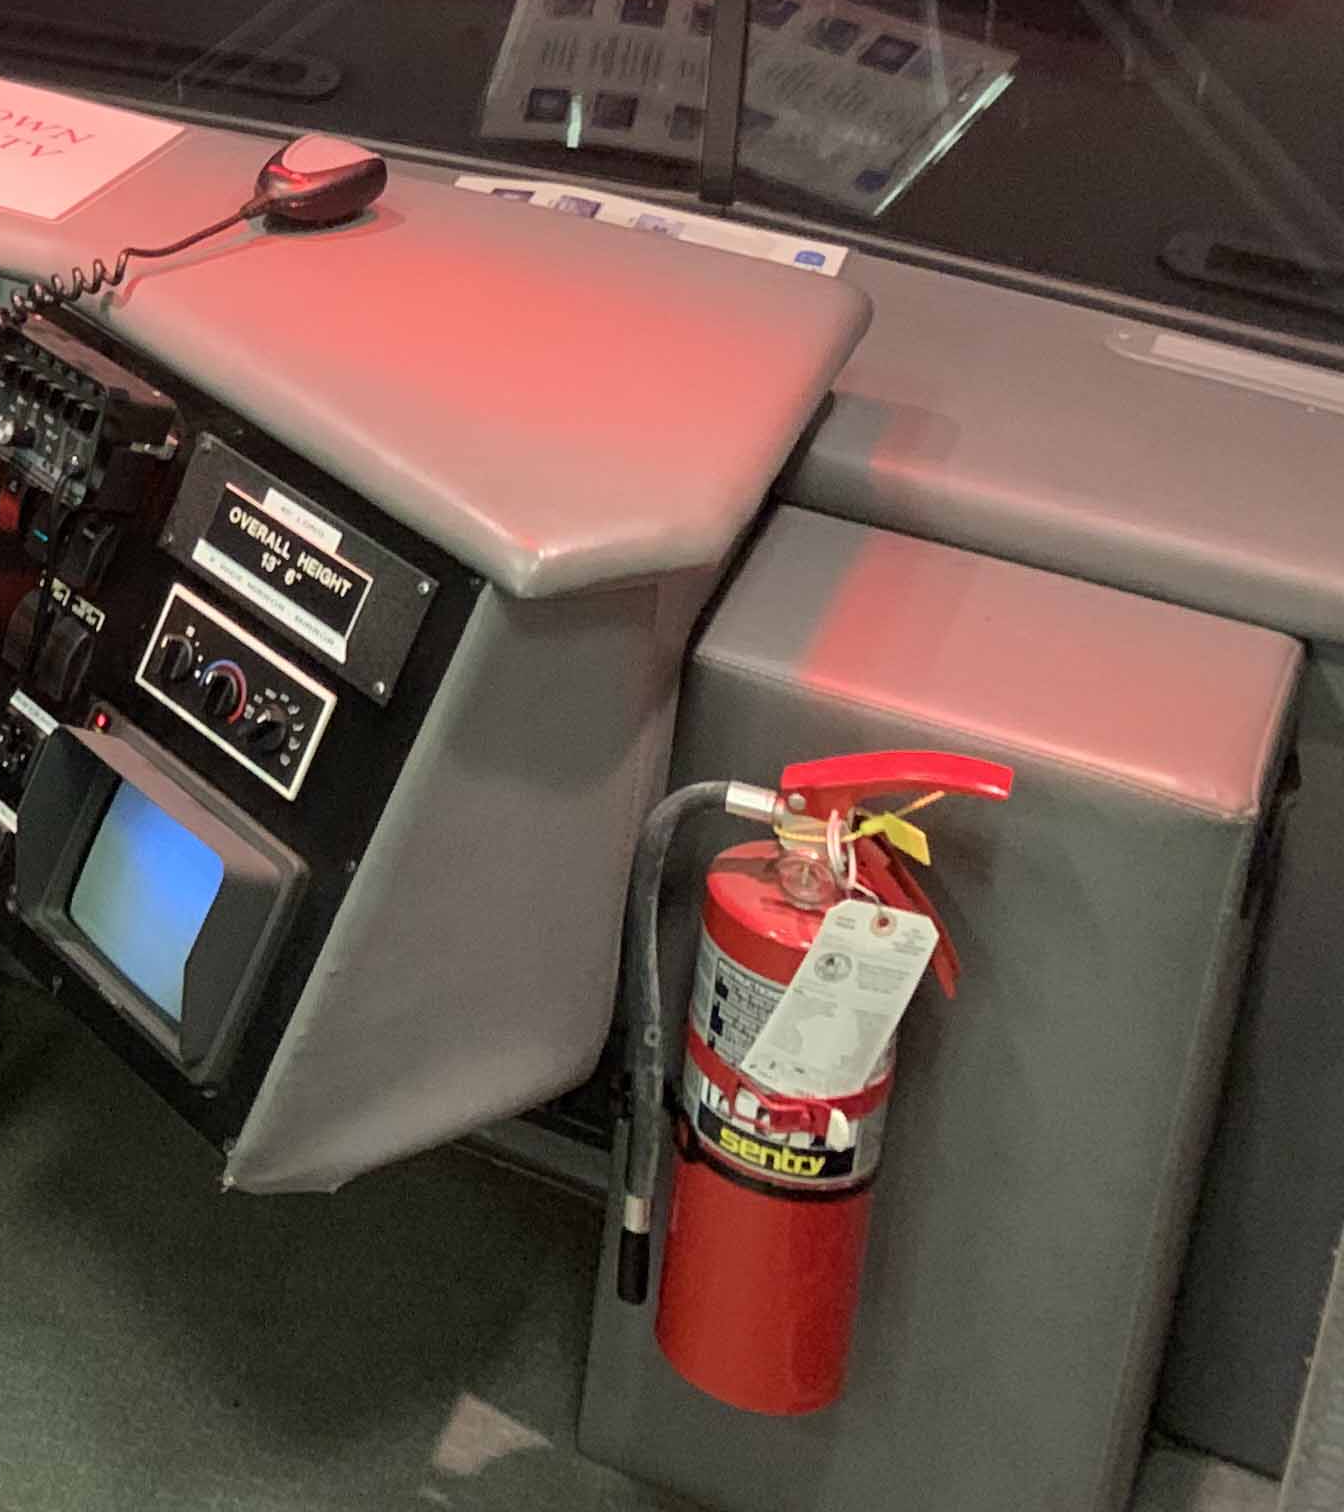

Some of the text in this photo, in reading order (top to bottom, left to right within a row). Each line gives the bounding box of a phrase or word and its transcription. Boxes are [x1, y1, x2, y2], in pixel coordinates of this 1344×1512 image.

[228, 505, 353, 599] OVERALL HEIGHT
[719, 1126, 825, 1176] sentry
